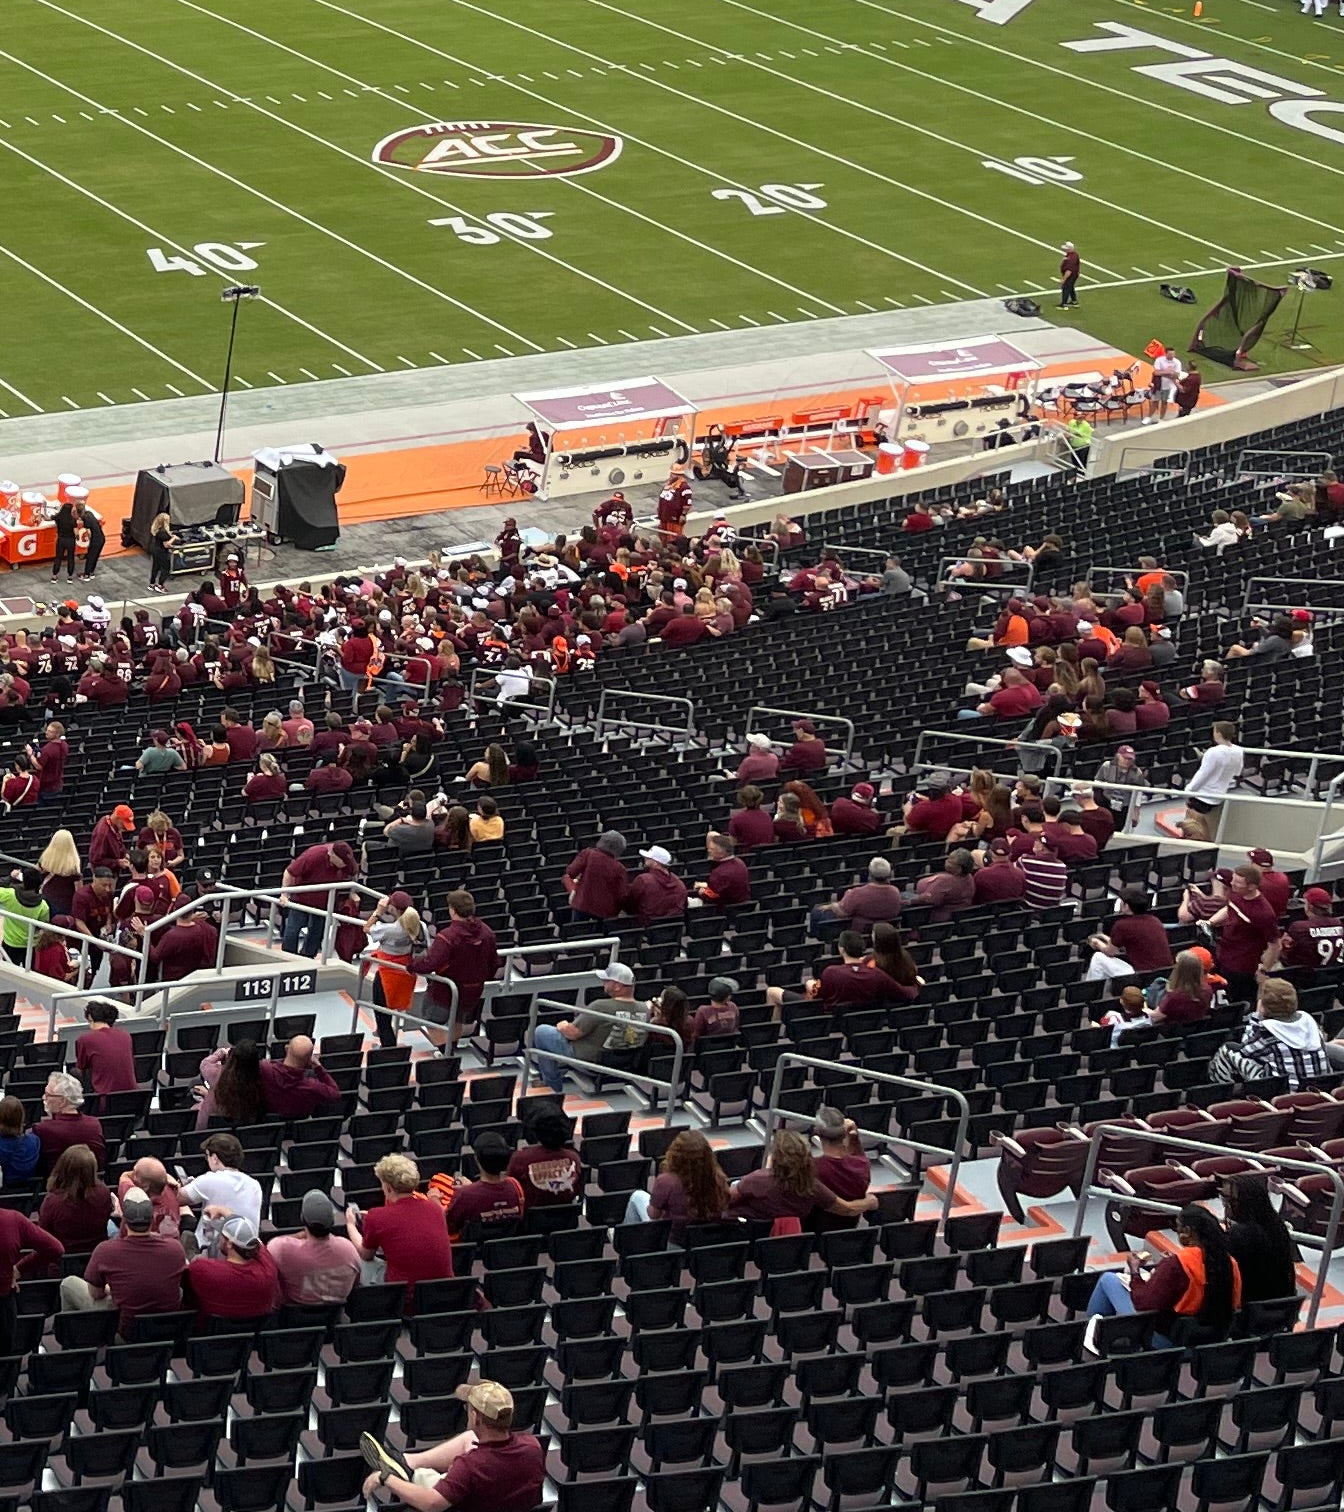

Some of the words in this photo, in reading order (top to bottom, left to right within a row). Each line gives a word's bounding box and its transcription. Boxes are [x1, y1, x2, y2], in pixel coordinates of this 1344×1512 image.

[414, 129, 588, 170] ACC
[980, 156, 1085, 186] 10
[711, 183, 828, 217] 20
[427, 211, 556, 247] 30
[145, 241, 261, 278] 40
[17, 533, 38, 557] G
[37, 661, 52, 674] 76
[242, 979, 272, 996] 113
[282, 975, 310, 992] 112
